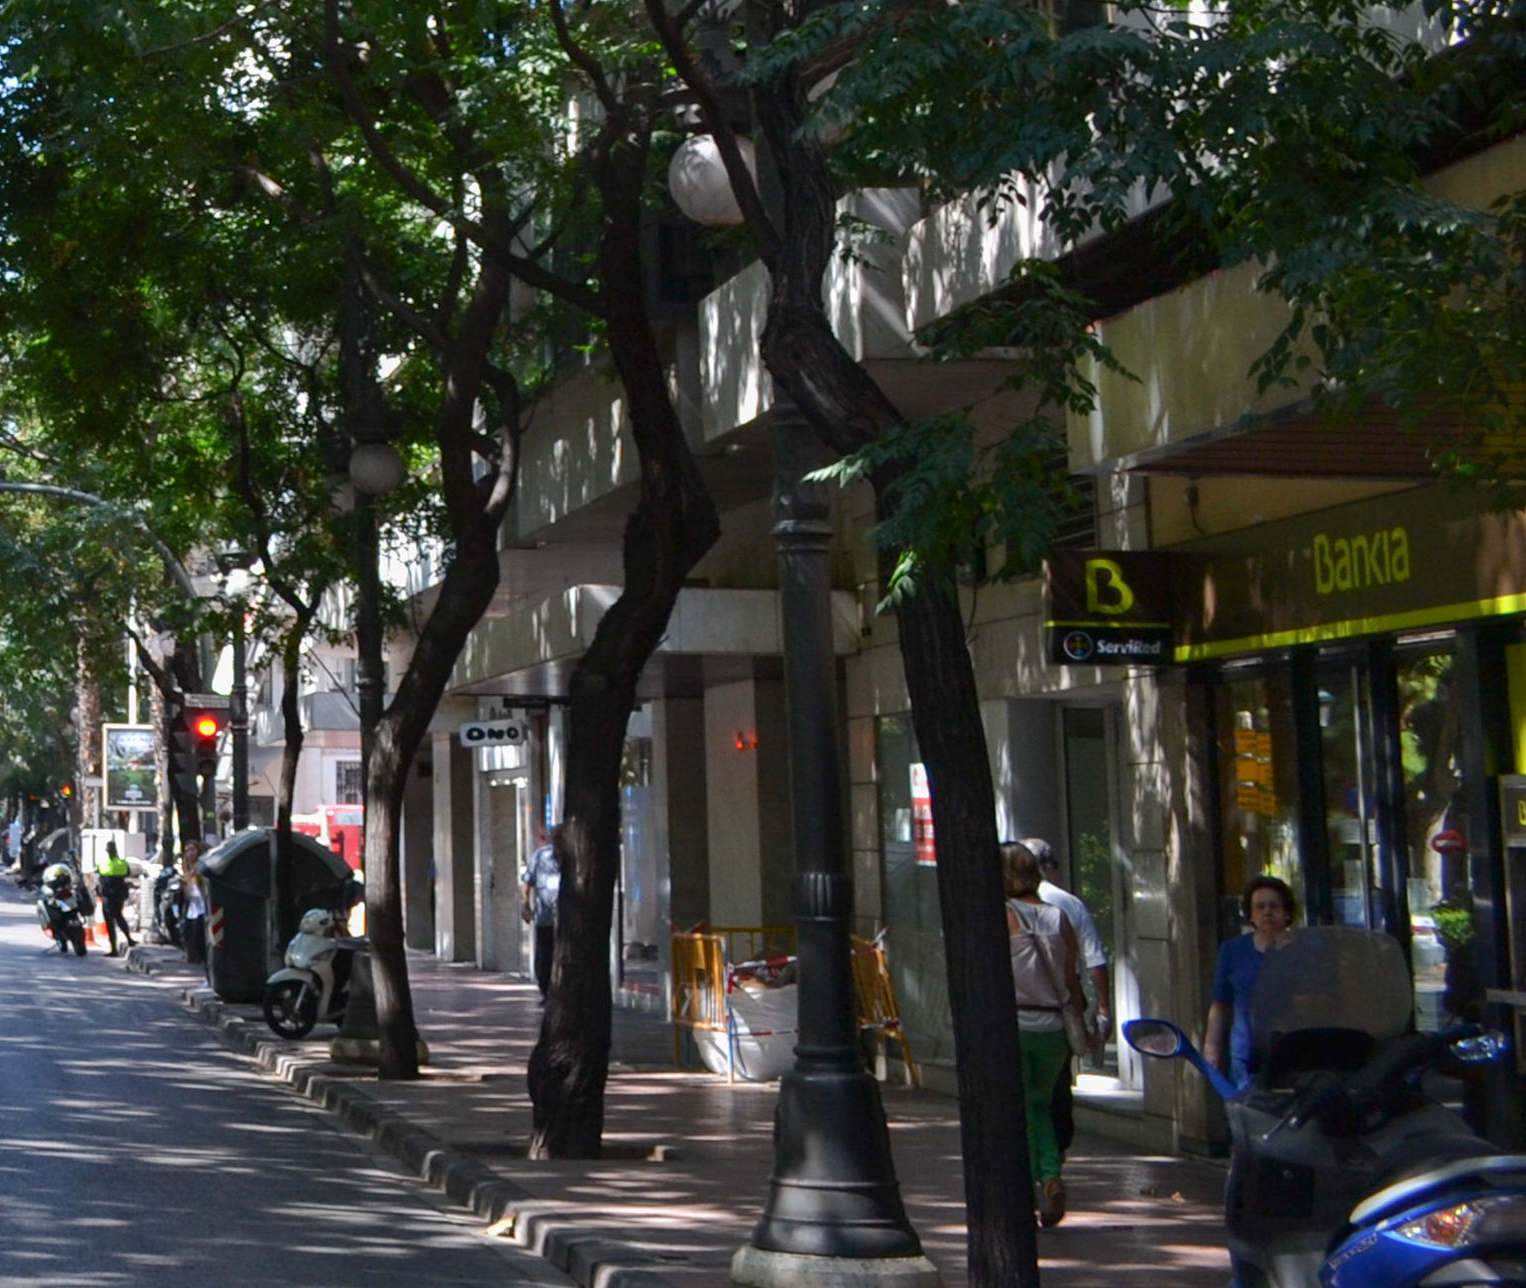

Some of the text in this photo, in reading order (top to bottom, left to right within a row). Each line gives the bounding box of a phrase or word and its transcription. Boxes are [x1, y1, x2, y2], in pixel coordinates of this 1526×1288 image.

[1085, 558, 1134, 615] B
[1313, 527, 1411, 595] Bankia
[1097, 638, 1162, 654] ServiRed
